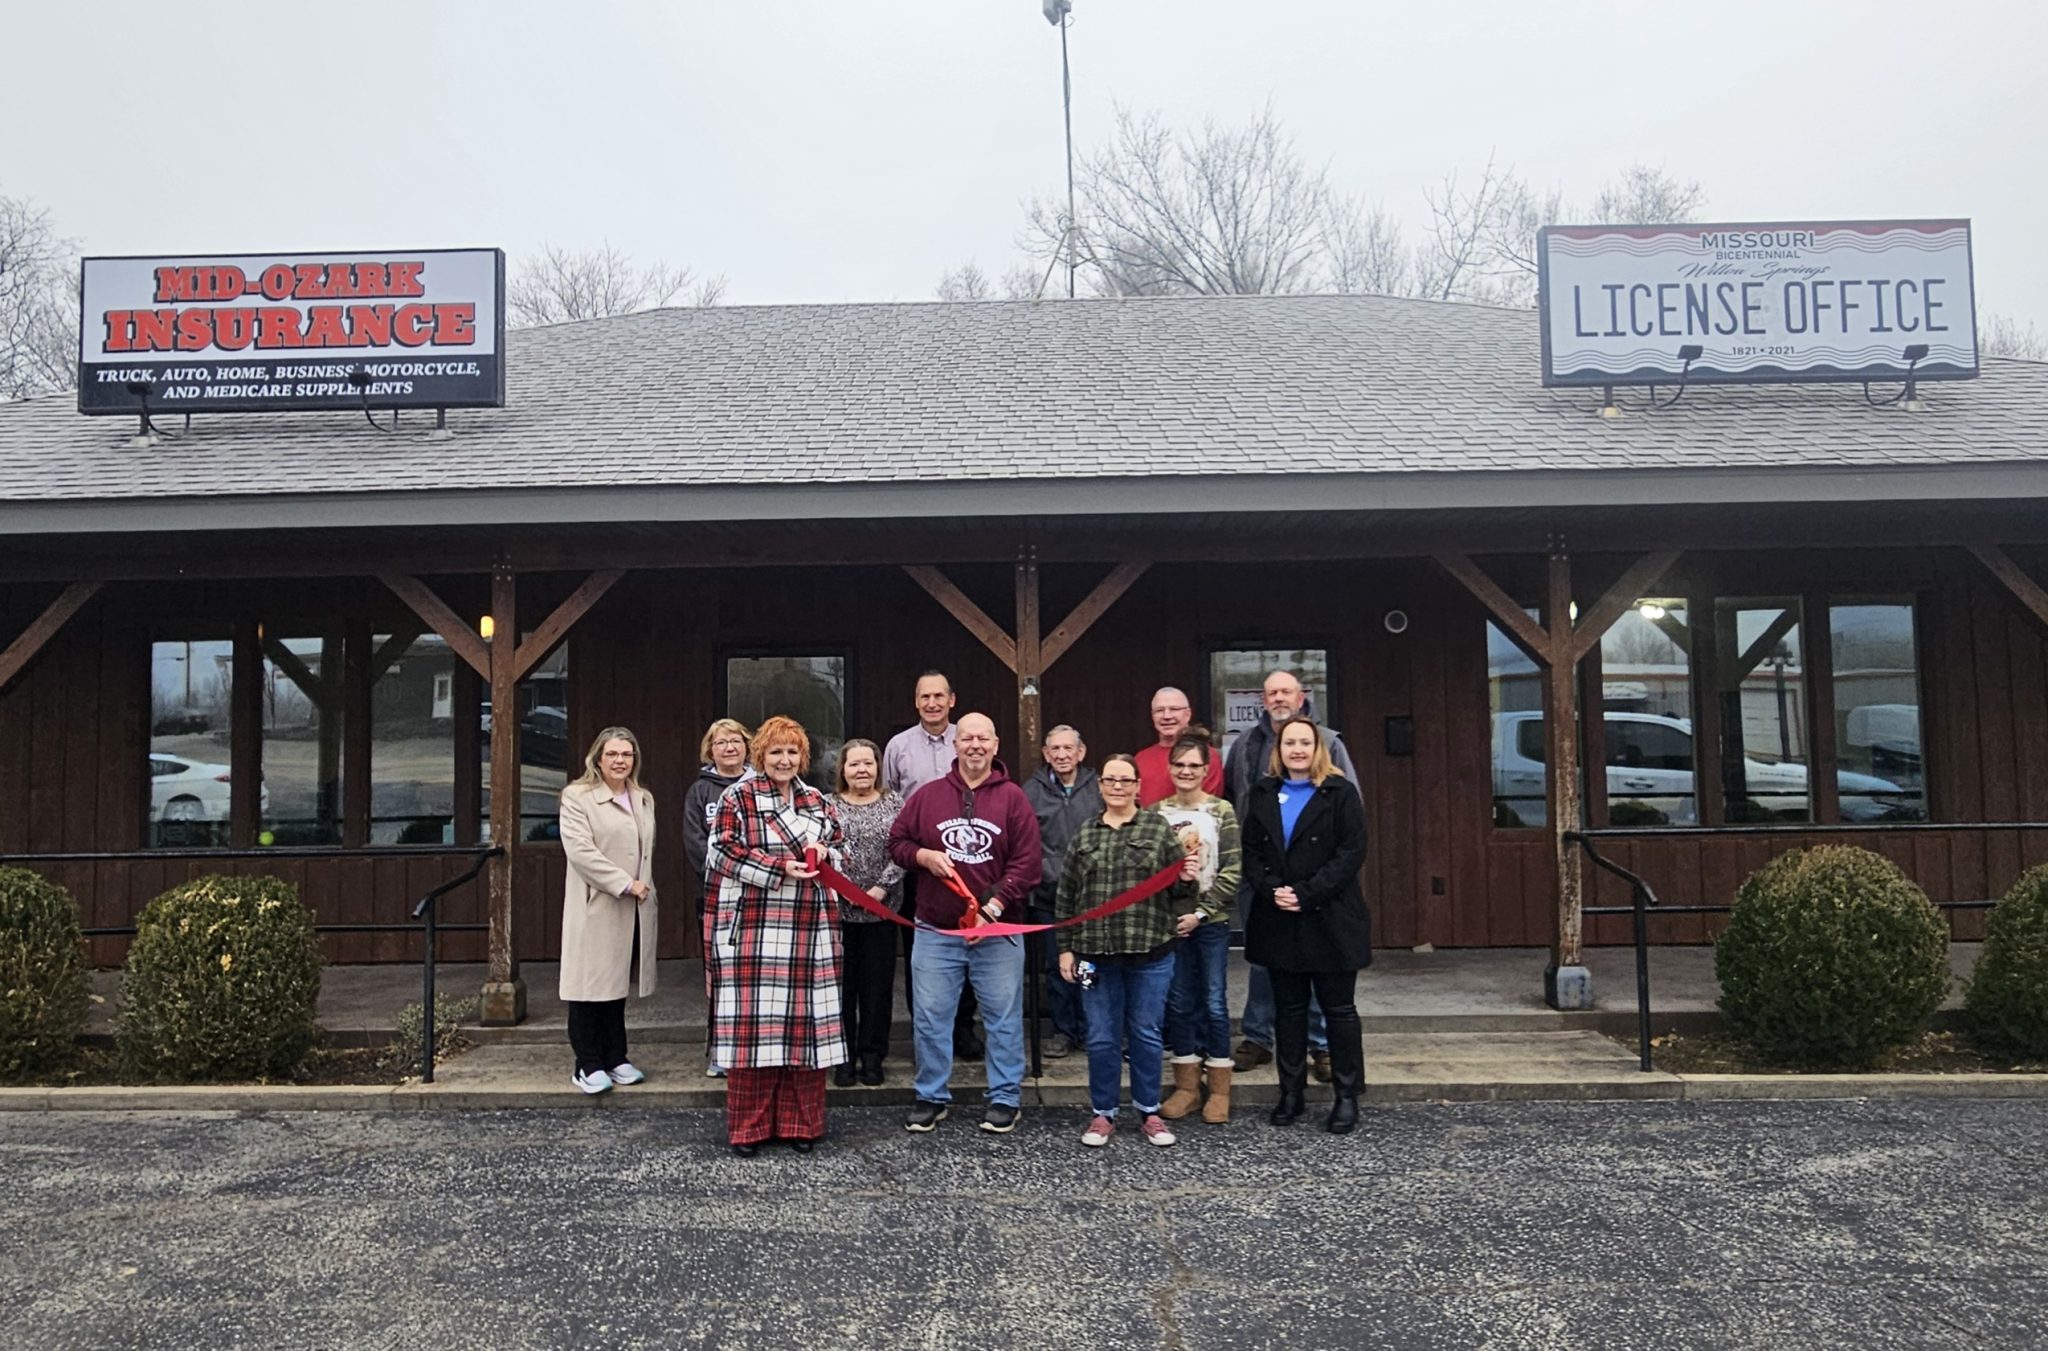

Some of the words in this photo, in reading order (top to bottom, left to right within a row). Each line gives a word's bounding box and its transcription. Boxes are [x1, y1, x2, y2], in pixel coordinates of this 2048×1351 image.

[1702, 232, 1814, 249] MISSOURI
[1716, 250, 1801, 261] BICENTENNIAL
[1677, 262, 1745, 278] Willow
[1750, 261, 1831, 281] Springs
[153, 261, 425, 303] MID-OZARK
[1574, 281, 1766, 337] LICENSE
[1784, 279, 1949, 334] OFFICE
[102, 302, 475, 353] INSURANCE
[1732, 346, 1756, 355] 1821
[1768, 346, 1795, 355] 2021
[97, 368, 157, 382] TRUCK,
[161, 367, 211, 382] AUTO,
[215, 366, 269, 381] HOME,
[364, 362, 481, 378] MOTORCYCLE,
[163, 386, 200, 399] AND
[203, 384, 292, 399] MEDICARE
